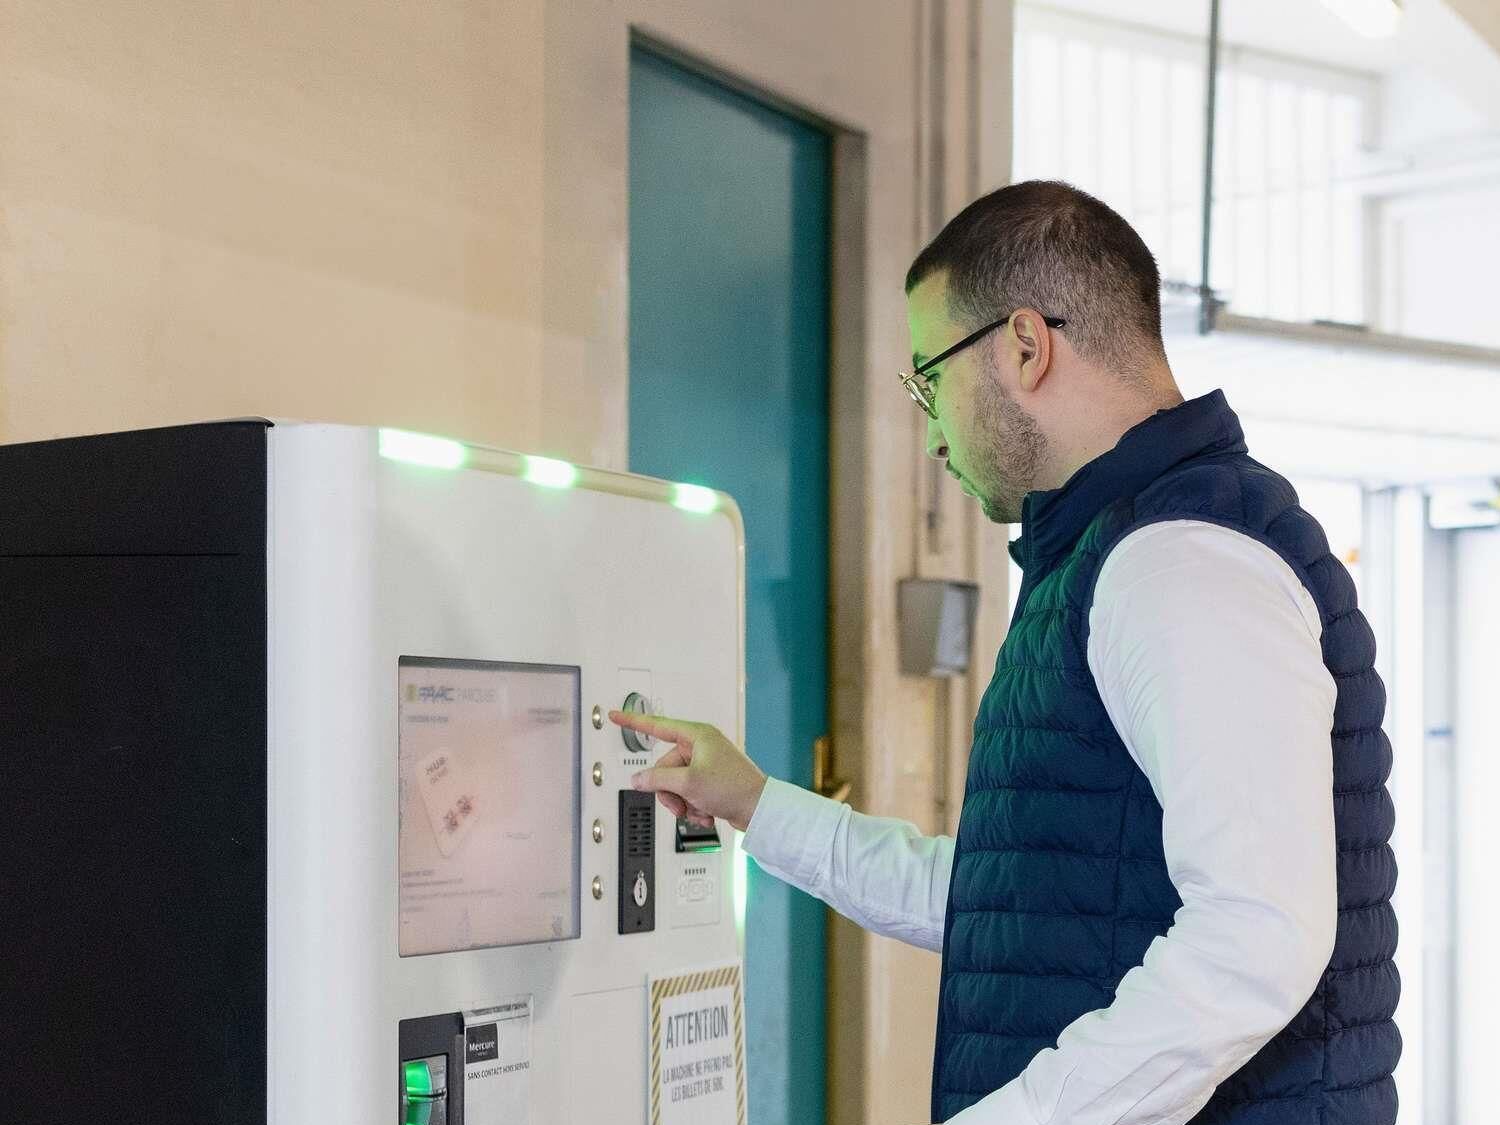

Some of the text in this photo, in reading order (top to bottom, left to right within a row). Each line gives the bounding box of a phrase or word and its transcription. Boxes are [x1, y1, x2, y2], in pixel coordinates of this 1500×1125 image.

[666, 1004, 729, 1049] ATTENTION
[469, 1041, 495, 1052] Mercure
[467, 1071, 481, 1081] SANS
